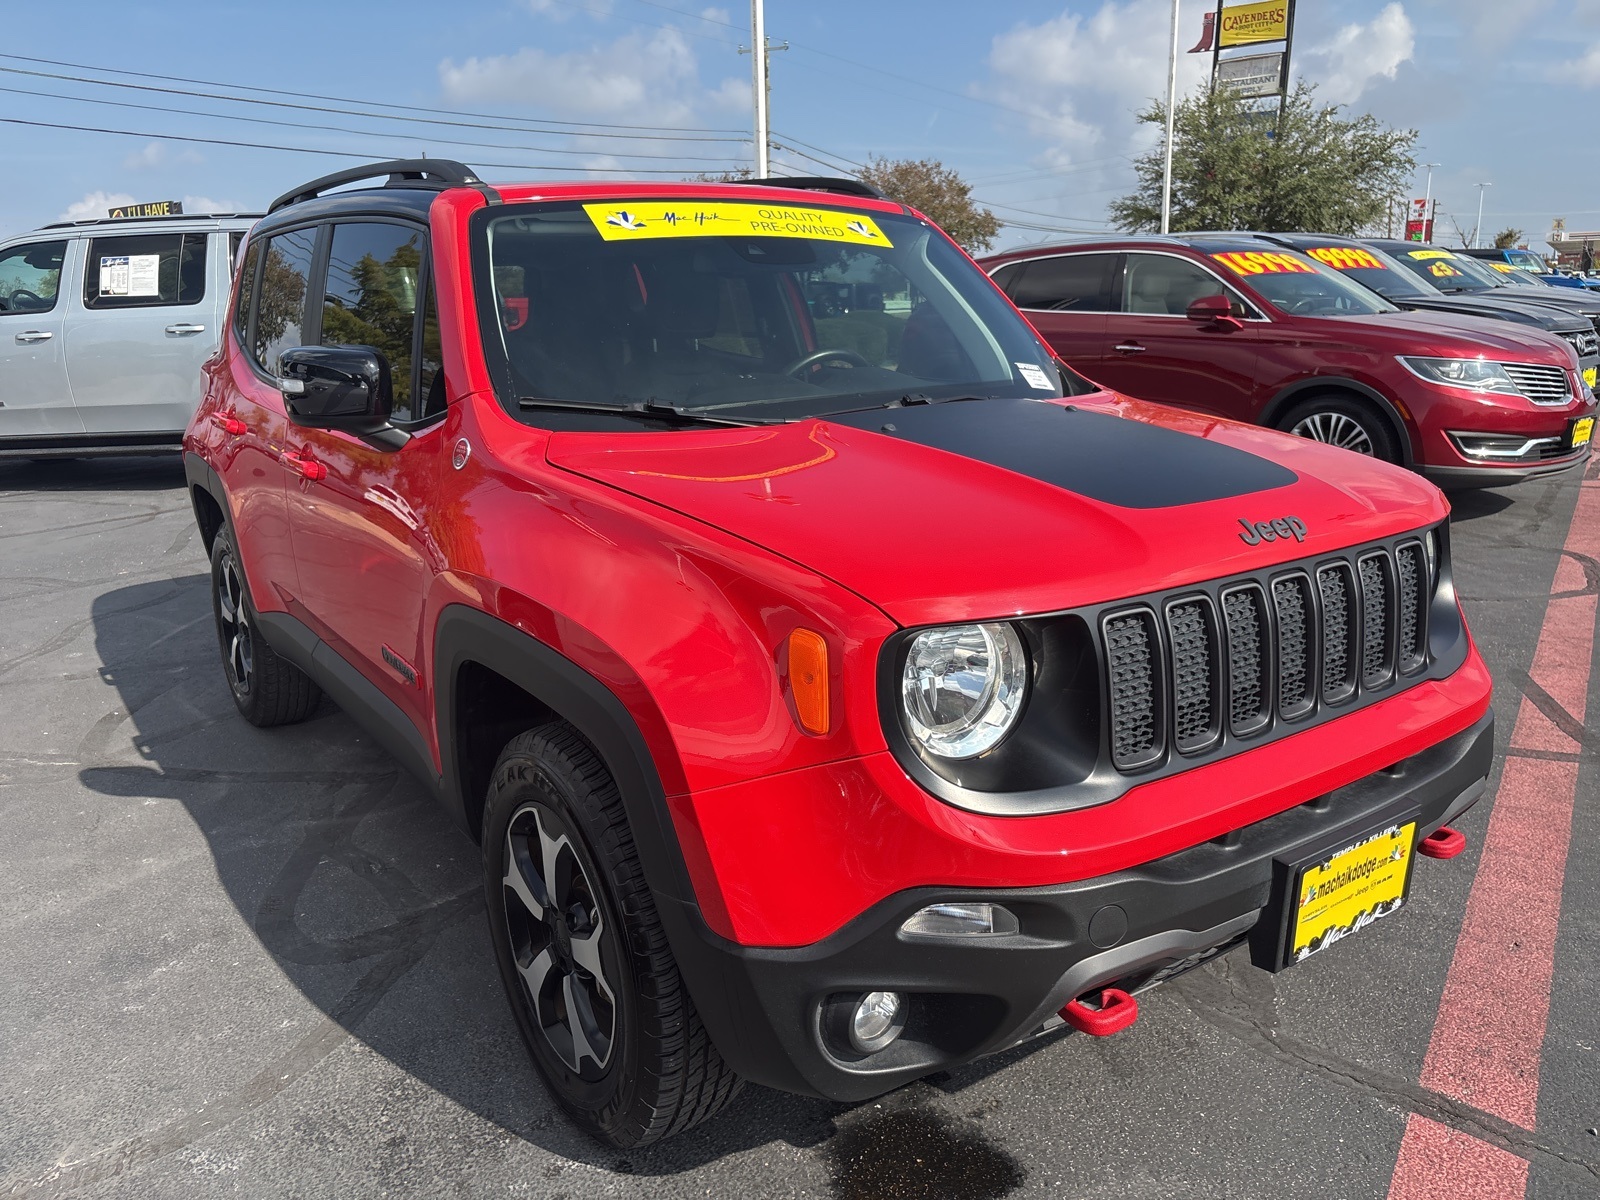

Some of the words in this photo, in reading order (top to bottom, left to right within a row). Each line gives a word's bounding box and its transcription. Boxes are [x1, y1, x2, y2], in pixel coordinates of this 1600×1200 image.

[1223, 8, 1285, 32] CAVENDER'S
[144, 203, 170, 216] HAVE
[657, 211, 692, 226] Mac
[694, 211, 730, 226] Haik
[758, 209, 823, 224] QUALITY
[750, 220, 844, 238] PRE-OWNED
[1212, 251, 1315, 275] 16999
[1238, 515, 1308, 546] Jeep
[1332, 842, 1360, 859] TEMPLE
[1369, 825, 1397, 842] KILLEEN
[1317, 856, 1388, 899] machaikdodge.com
[1355, 885, 1369, 897] Jeep
[1320, 926, 1351, 950] Mac
